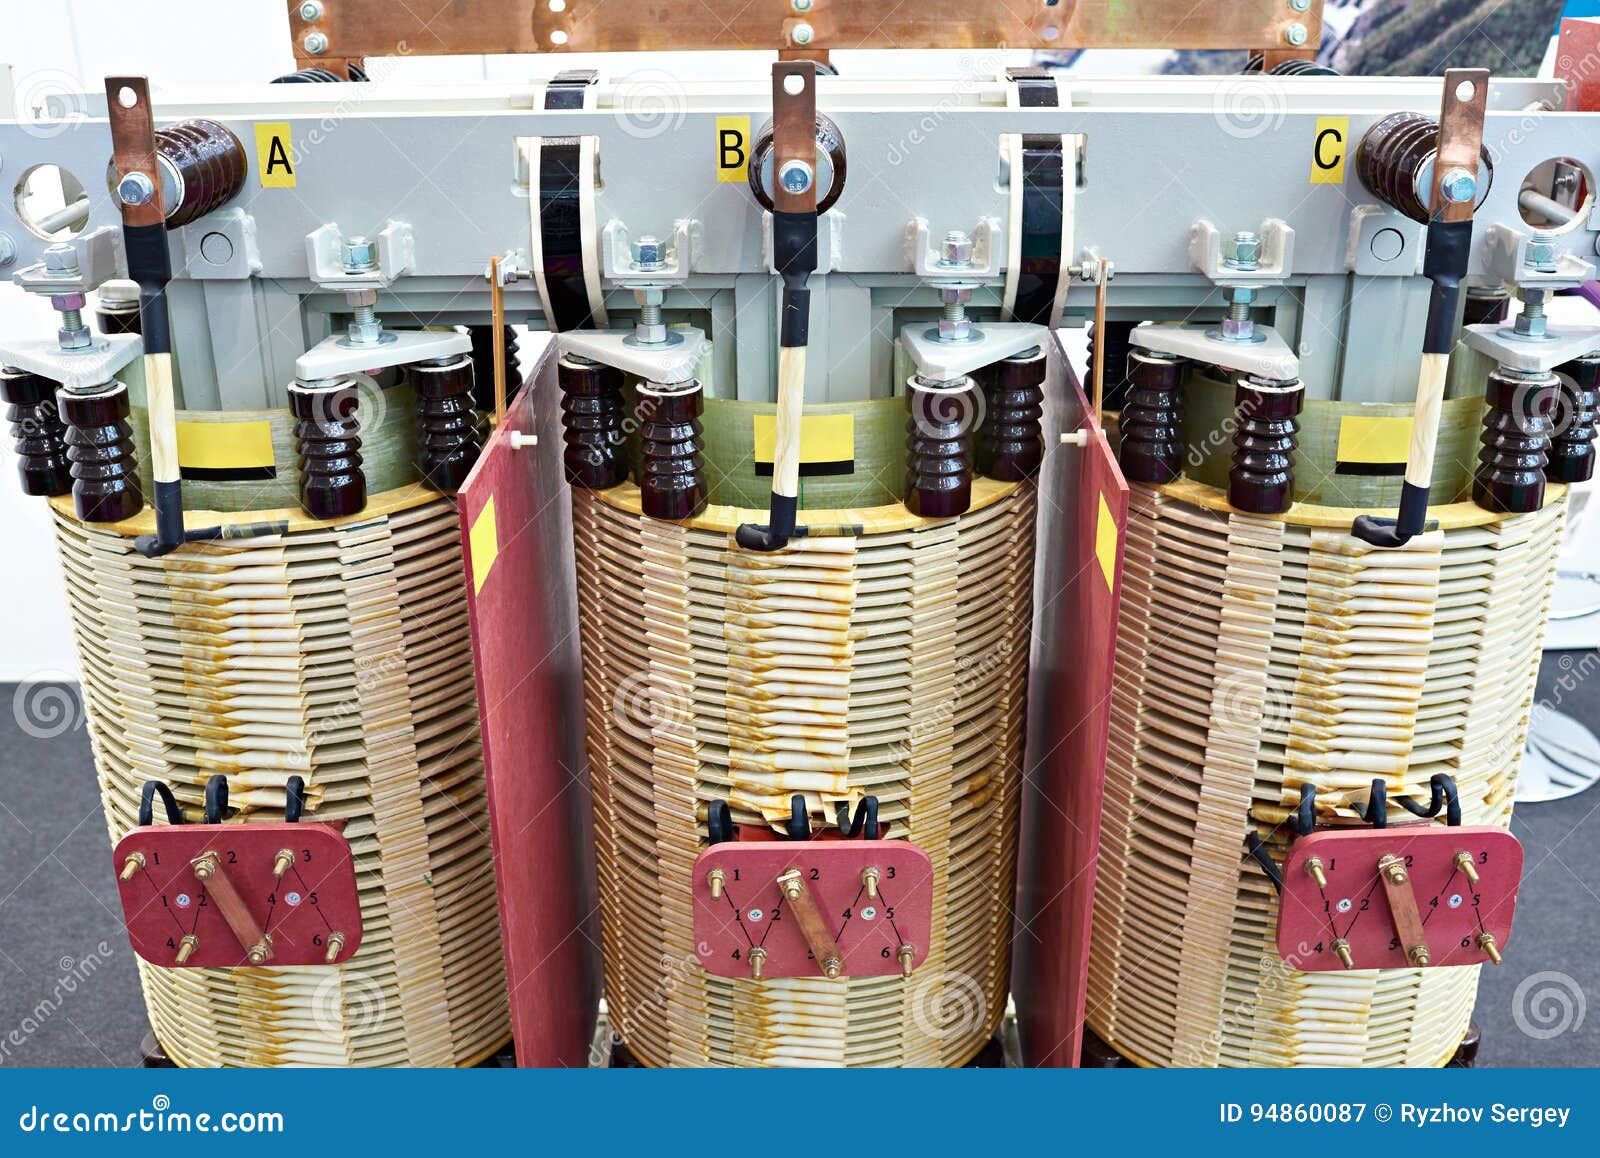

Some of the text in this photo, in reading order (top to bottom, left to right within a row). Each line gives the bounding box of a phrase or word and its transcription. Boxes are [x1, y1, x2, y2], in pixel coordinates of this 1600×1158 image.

[267, 136, 292, 174] A
[720, 130, 744, 168] B
[1315, 129, 1341, 169] C
[154, 850, 312, 865] 1 2 3
[1330, 853, 1488, 870] 1 2 3
[734, 868, 895, 880] 1 2 3
[163, 893, 317, 907] 1 2 4 5
[1324, 894, 1480, 911] 1 2 4 5
[735, 908, 894, 920] 1 2 4 5
[166, 935, 321, 949] 4 6
[1314, 935, 1470, 953] 4 5 6
[732, 950, 740, 960] 4
[881, 948, 890, 958] 6
